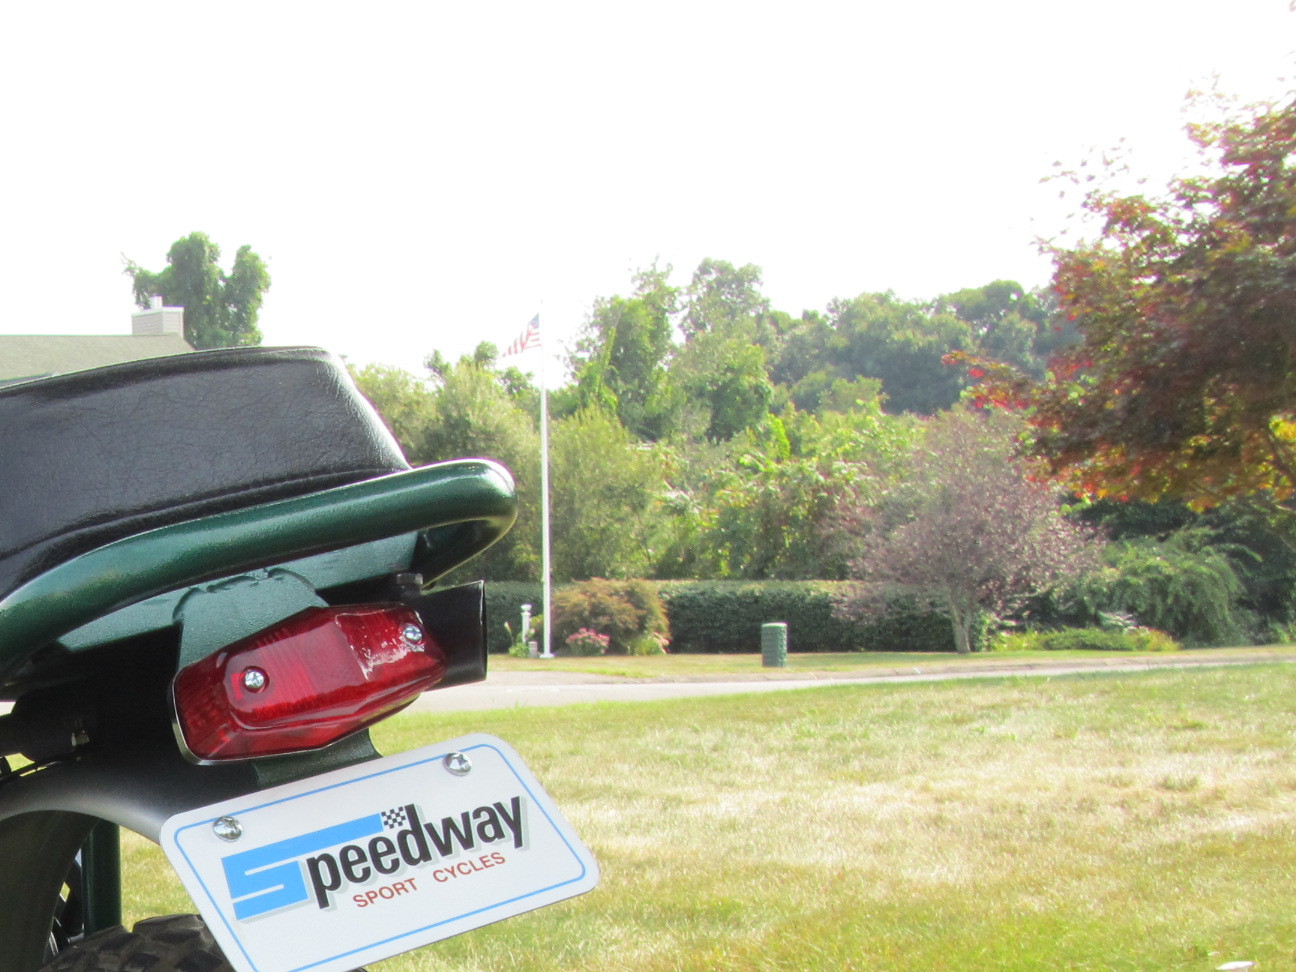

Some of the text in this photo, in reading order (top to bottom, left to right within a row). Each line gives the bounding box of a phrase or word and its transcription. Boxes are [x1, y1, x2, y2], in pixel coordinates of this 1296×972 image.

[221, 796, 522, 921] Speedway
[352, 851, 506, 907] SPORT CYCLES
